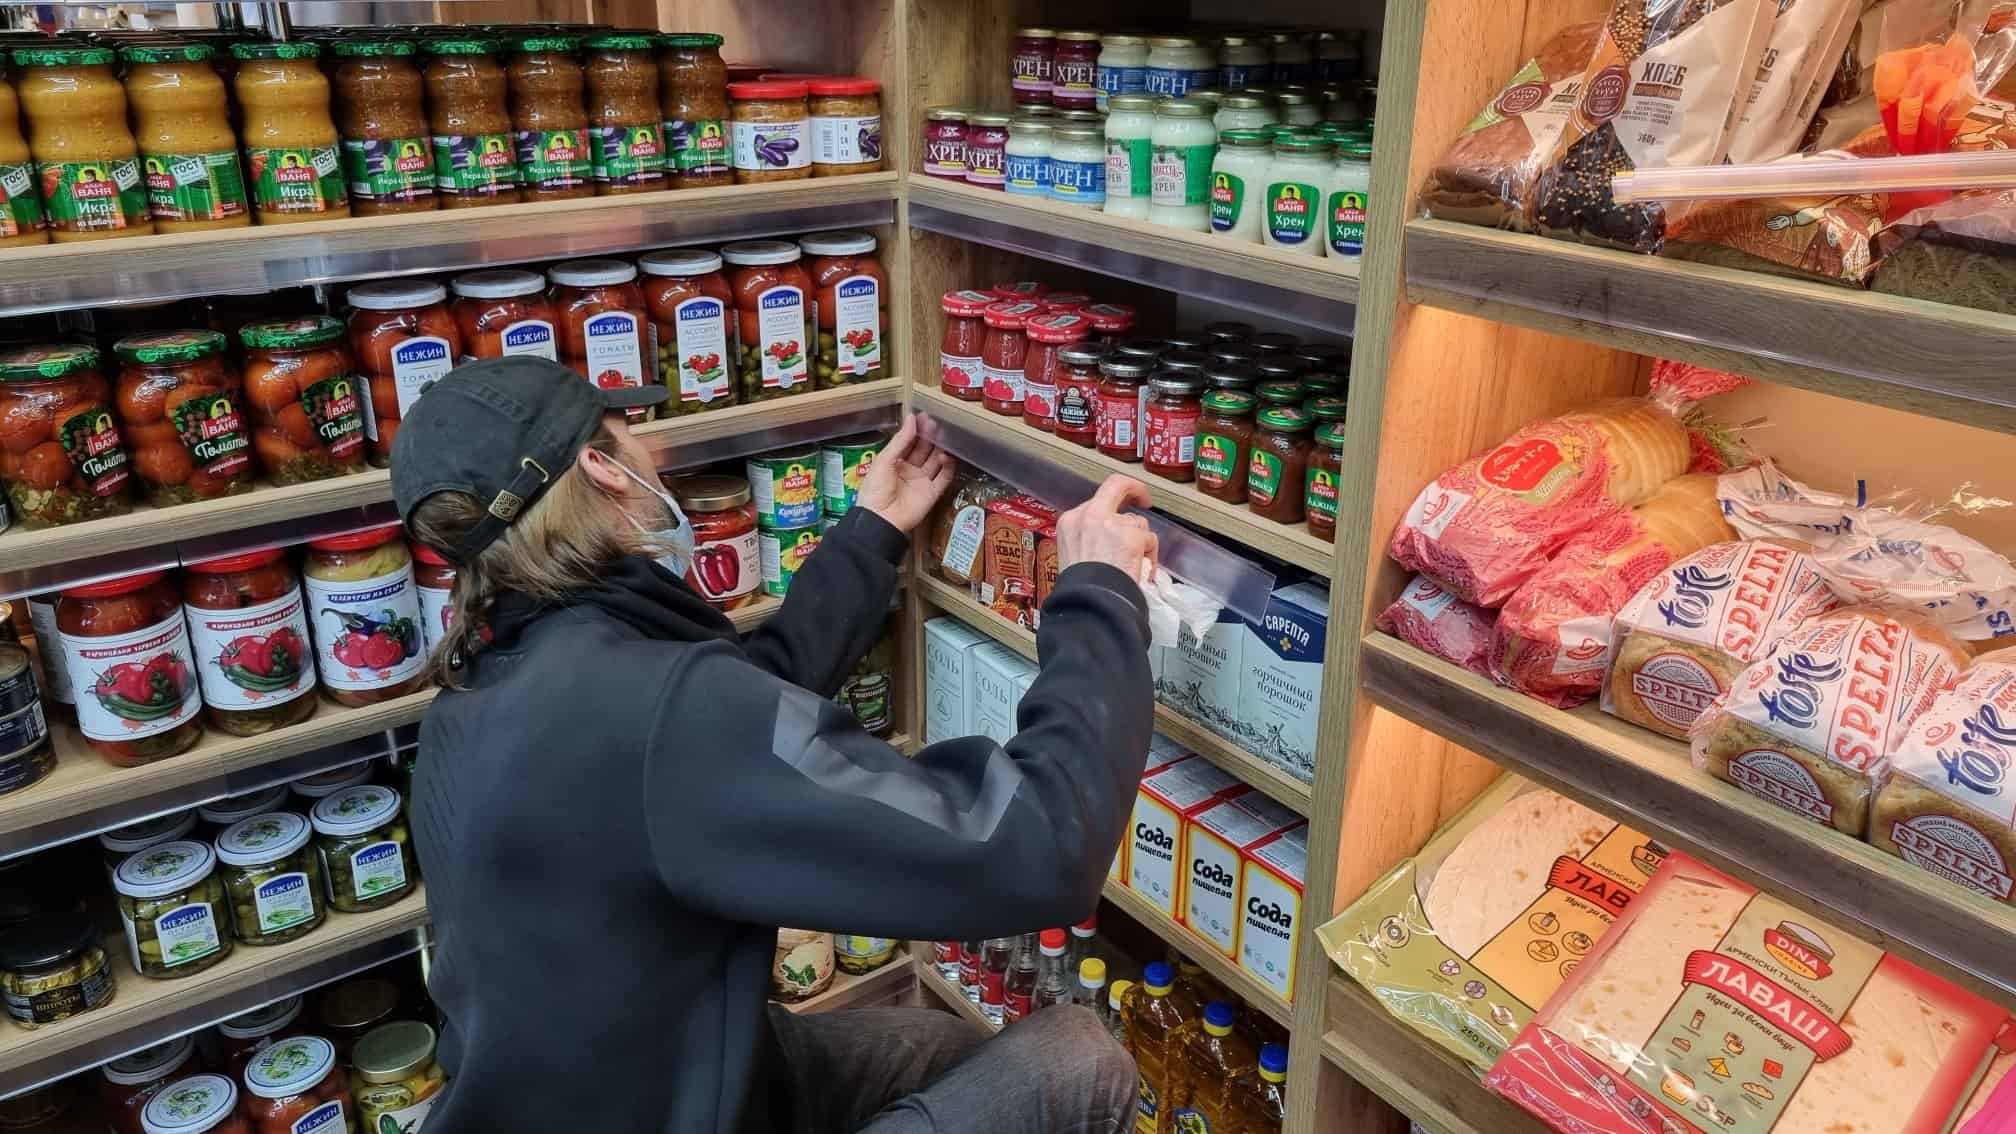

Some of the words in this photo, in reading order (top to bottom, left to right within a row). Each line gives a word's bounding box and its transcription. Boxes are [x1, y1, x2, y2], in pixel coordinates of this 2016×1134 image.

[1013, 59, 1050, 76] ХРЕН
[1145, 73, 1189, 94] ХРЕН
[633, 147, 656, 157] ВАНЯ
[701, 139, 722, 149] ВАНЯ
[313, 153, 335, 166] ГОСТ
[485, 156, 508, 166] ВАНЯ
[549, 152, 575, 161] ВАНЯ
[114, 163, 136, 180] ГОСТ
[172, 162, 200, 176] ГОСТ
[401, 161, 425, 171] ВАНЯ
[1005, 161, 1050, 181] ХРЕН
[4, 168, 26, 185] ГОСТ
[280, 173, 311, 182] ВАНЯ
[1049, 166, 1092, 187] ХРЕН
[77, 187, 112, 197] ВАНЯ
[280, 187, 315, 199] Икра
[79, 203, 117, 216] Икра
[1277, 203, 1304, 212] ВАНЯ
[1275, 214, 1305, 227] Хрен
[841, 285, 874, 297] НЕЖИН
[763, 296, 799, 309] НЕЖИН
[681, 306, 720, 319] НЕЖИН
[591, 322, 633, 335] НЕЖИН
[508, 331, 549, 345] НЕЖИН
[400, 345, 445, 362] НЕЖИН
[591, 343, 636, 355] ТОМАТЫ
[208, 418, 240, 434] ВАНЯ
[195, 436, 250, 460] Томаты
[994, 541, 1021, 559] КВАС
[1722, 548, 1788, 660] SPELTA
[1265, 614, 1311, 647] САРЕПТА
[1177, 640, 1222, 671] порошок
[1250, 665, 1314, 702] горчичный
[1256, 681, 1308, 712] порошок
[1635, 676, 1712, 710] SPELT
[1834, 621, 1901, 771] SPELTA
[1730, 764, 1825, 815] SPELTA
[1135, 822, 1174, 850] Сода
[357, 848, 398, 866] НЕЖИН
[1135, 840, 1173, 862] пищевая
[1895, 828, 2005, 894] SPELTA
[1193, 858, 1234, 888] Сода
[260, 880, 304, 898] НЕЖИН
[1192, 877, 1234, 900] пищевая
[1564, 871, 1632, 909] ЛАВ
[163, 909, 208, 930] НЕЖИН
[1247, 896, 1292, 929] Сода
[1246, 915, 1291, 940] пищевая
[1724, 945, 1778, 977] АРМЕНСКИ
[1776, 936, 1820, 972] DINA
[1701, 960, 1830, 1043] ЛАВАШ
[1705, 991, 1733, 1011] Идеи
[1731, 1004, 1746, 1019] за
[1460, 1026, 1480, 1044] 250
[298, 1105, 339, 1134] НЕЖИН
